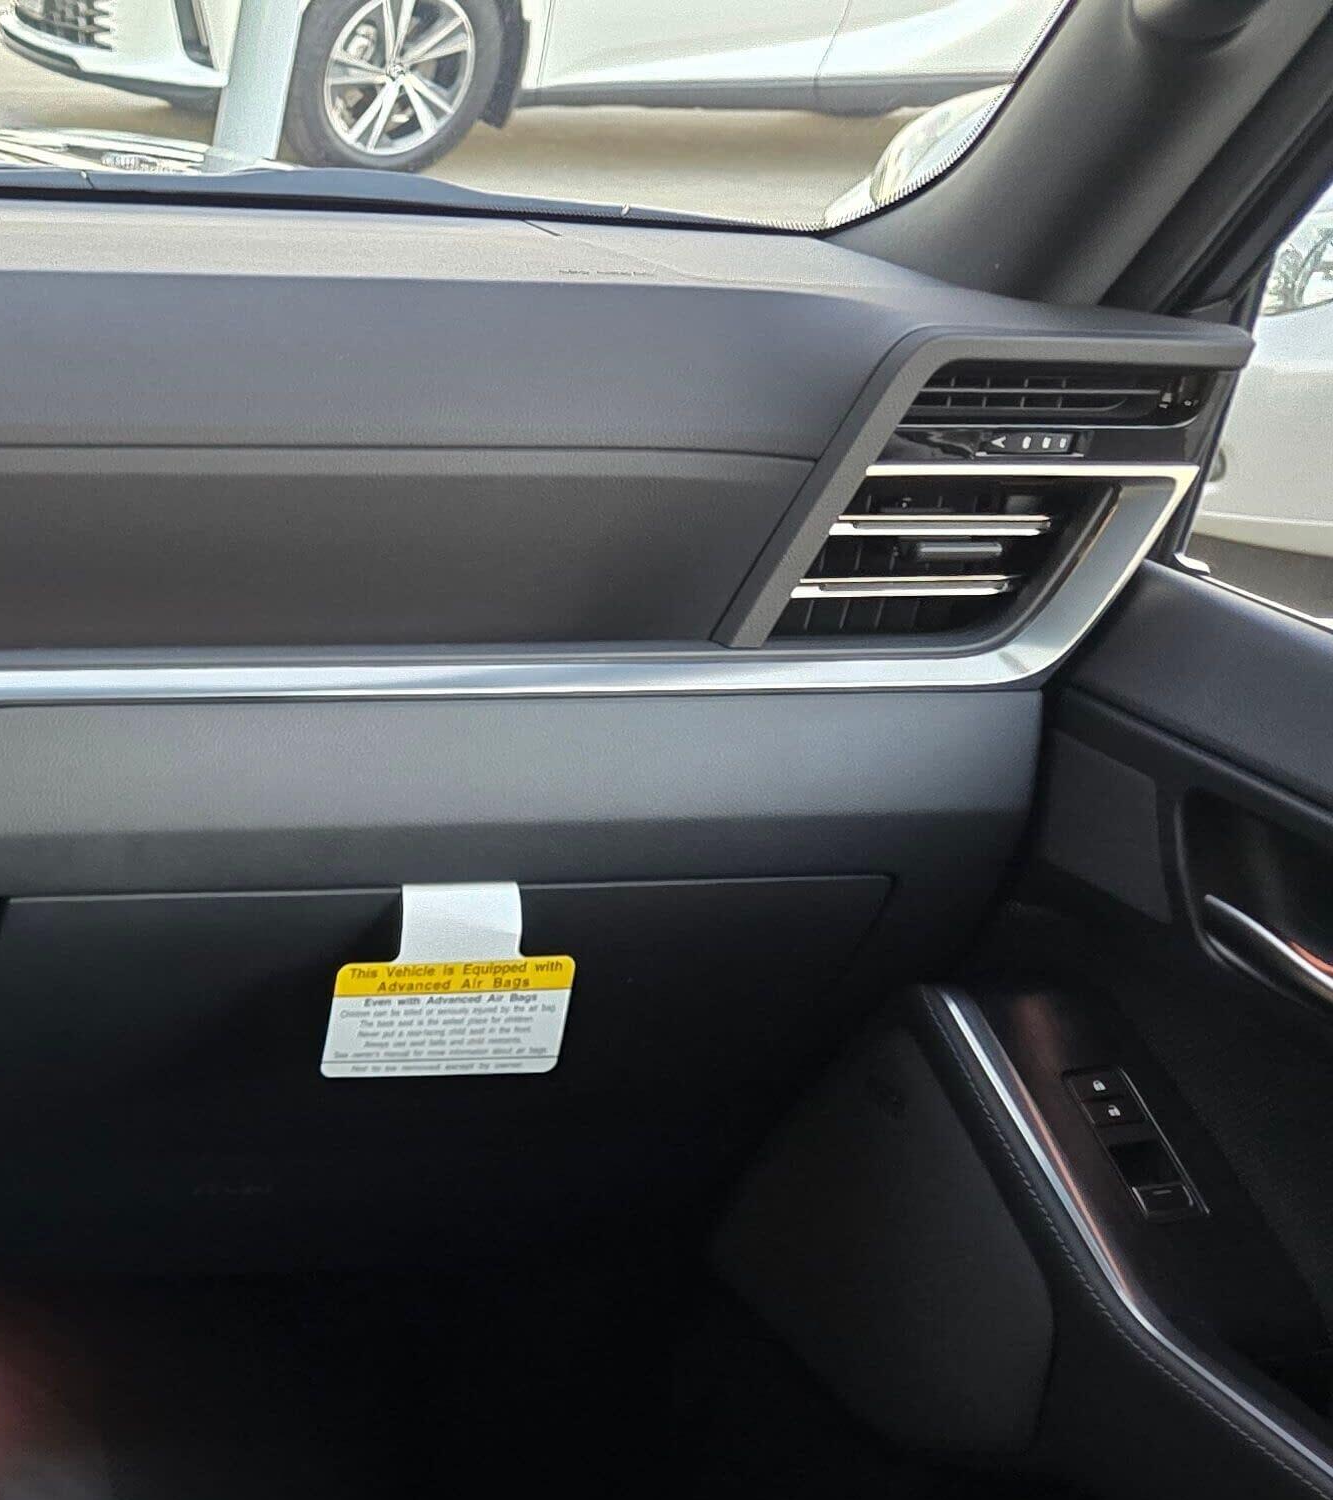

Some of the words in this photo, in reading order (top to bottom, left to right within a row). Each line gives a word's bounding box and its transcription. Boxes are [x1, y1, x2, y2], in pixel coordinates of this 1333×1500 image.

[349, 967, 378, 980] This
[386, 965, 436, 978] Vehicle
[442, 966, 454, 977] is
[462, 962, 528, 977] Equipped
[534, 960, 563, 973] with
[377, 980, 452, 992] Advanced
[460, 979, 483, 989] Air
[493, 977, 530, 990] Bags
[364, 998, 392, 1007] Even
[397, 997, 421, 1006] with
[425, 994, 482, 1005] Advanced
[487, 994, 504, 1003] Air
[509, 992, 537, 1003] Bags
